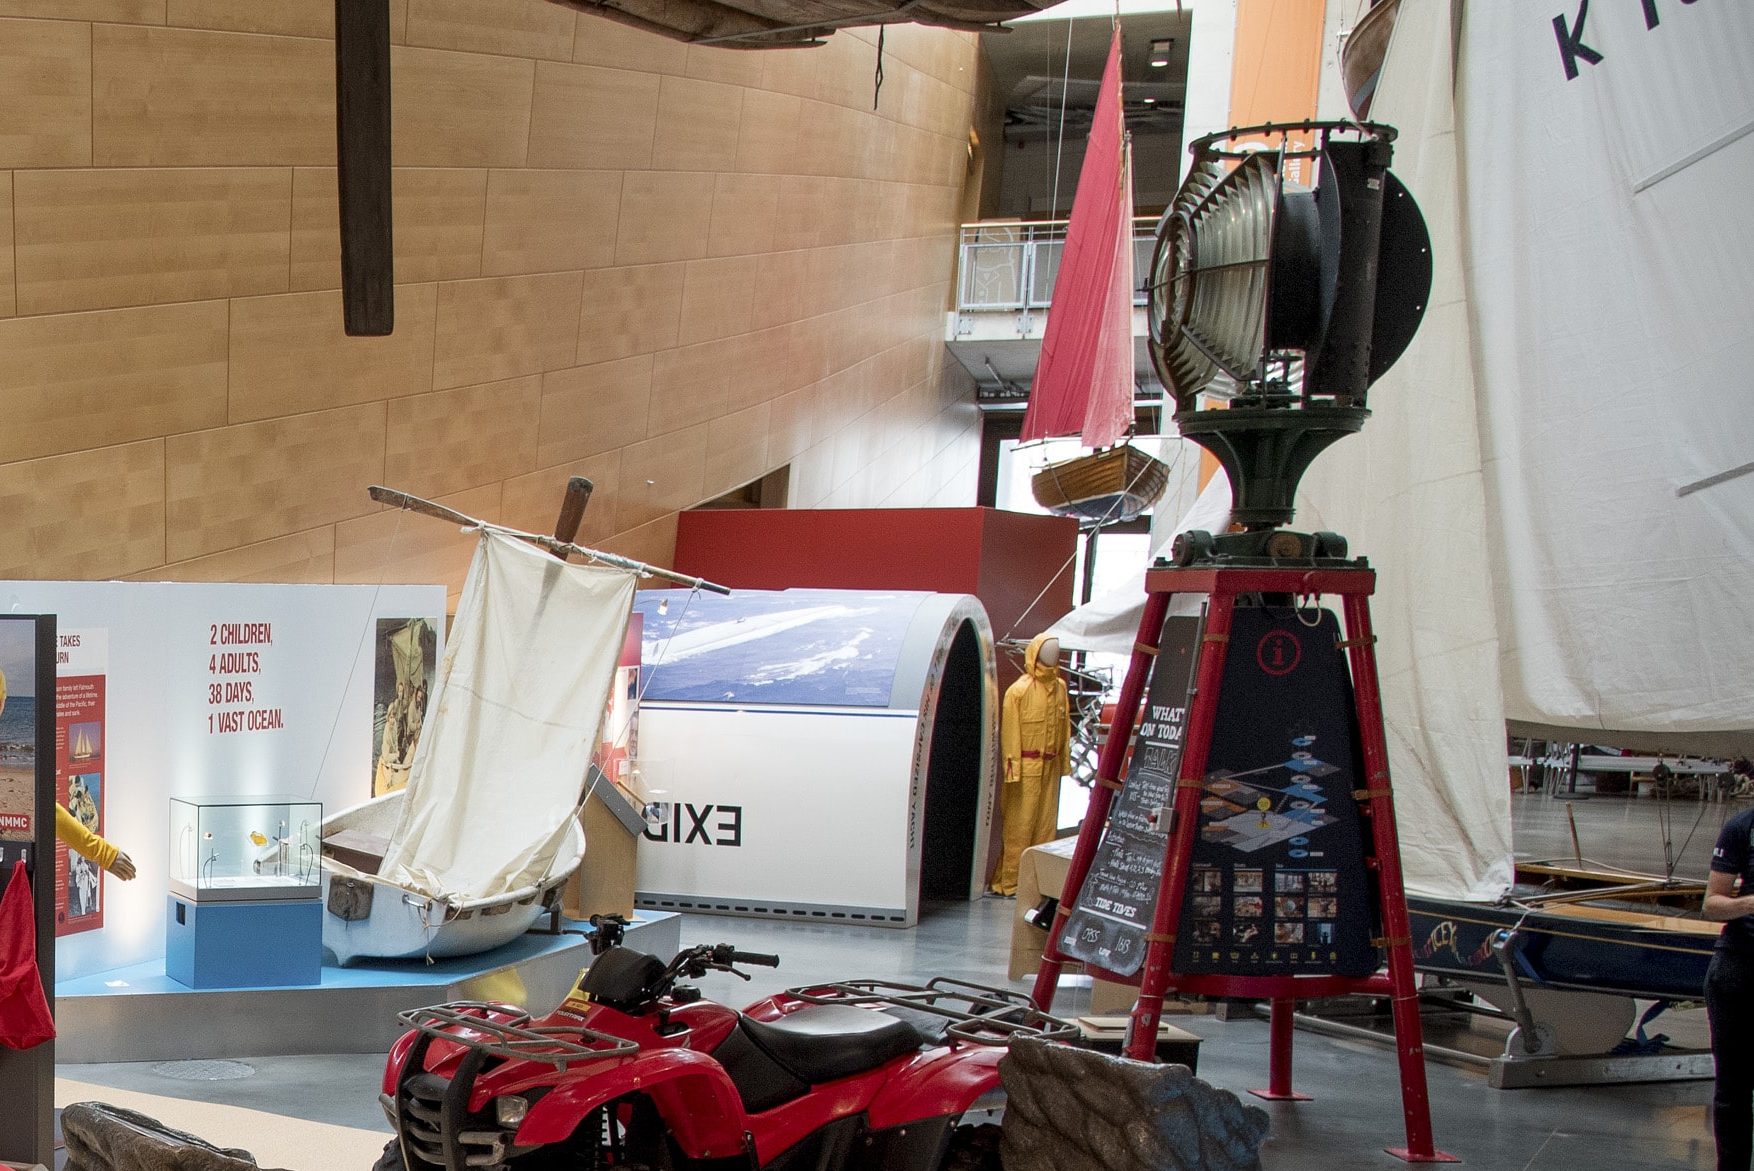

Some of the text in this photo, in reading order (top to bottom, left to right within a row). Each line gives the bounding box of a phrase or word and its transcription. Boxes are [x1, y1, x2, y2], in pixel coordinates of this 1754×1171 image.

[60, 635, 80, 647] TAKES
[210, 623, 272, 646] 2 CHILDREN,
[209, 652, 261, 675] 4 ADULTS,
[209, 681, 254, 704] 38 DAYS,
[209, 709, 283, 733] 1 VAST OCEAN.
[1153, 706, 1185, 722] WHAT
[1140, 723, 1182, 740] ON TODA
